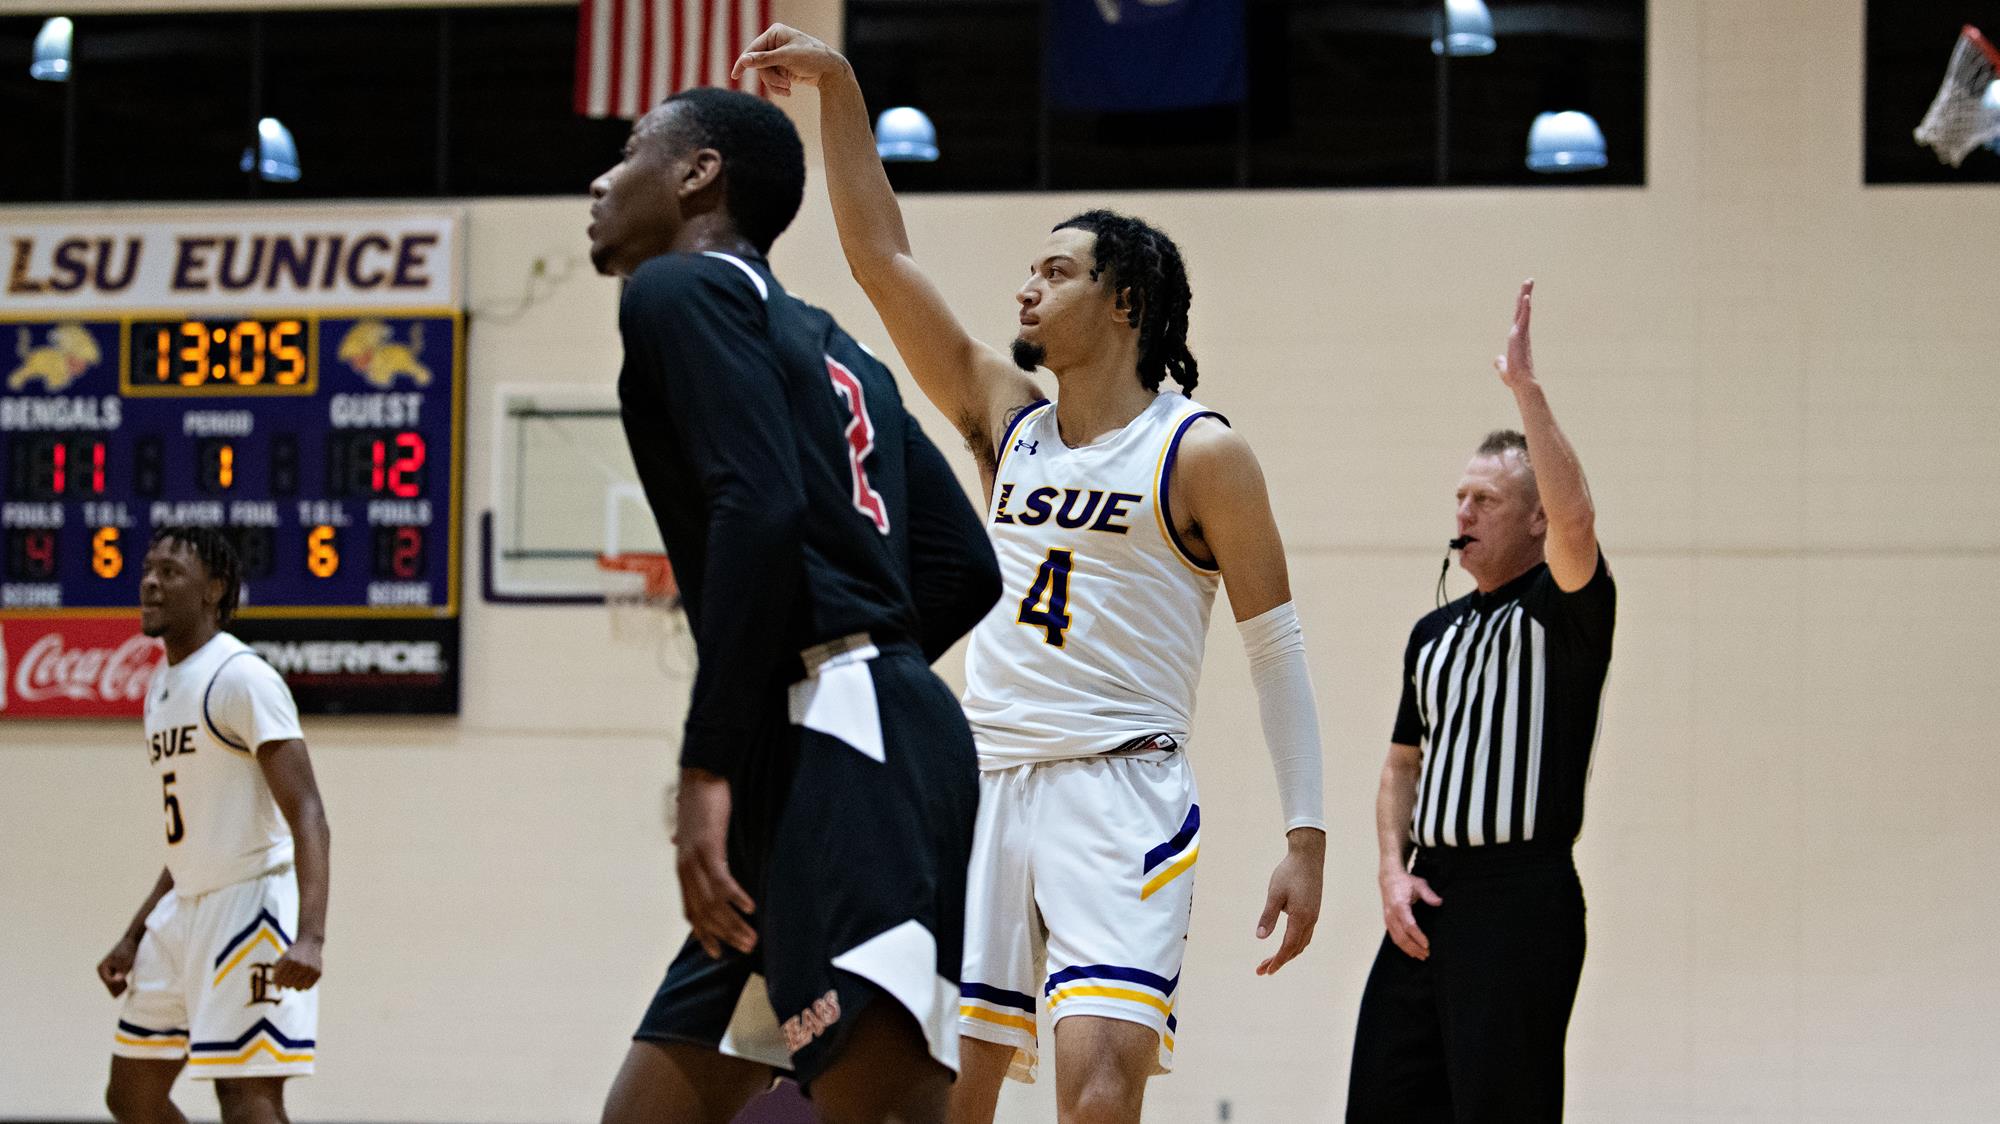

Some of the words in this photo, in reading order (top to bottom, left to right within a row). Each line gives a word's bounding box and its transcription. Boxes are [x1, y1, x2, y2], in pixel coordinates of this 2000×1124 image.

[7, 235, 143, 293] LSU
[171, 234, 438, 291] EUNICE
[156, 320, 306, 387] 13:05
[183, 410, 254, 436] PERIOD
[329, 392, 423, 428] GUEST
[52, 443, 105, 494] 11
[219, 445, 233, 488] 1
[371, 432, 426, 498] 12
[824, 353, 890, 535] 2
[3, 502, 64, 528] FOULS
[150, 502, 224, 528] PLAYER
[367, 500, 432, 526] FOULS
[994, 483, 1143, 535] LSUE
[92, 526, 123, 578] 6
[307, 525, 339, 577] 6
[1016, 547, 1074, 648] 4
[162, 771, 185, 844] 5
